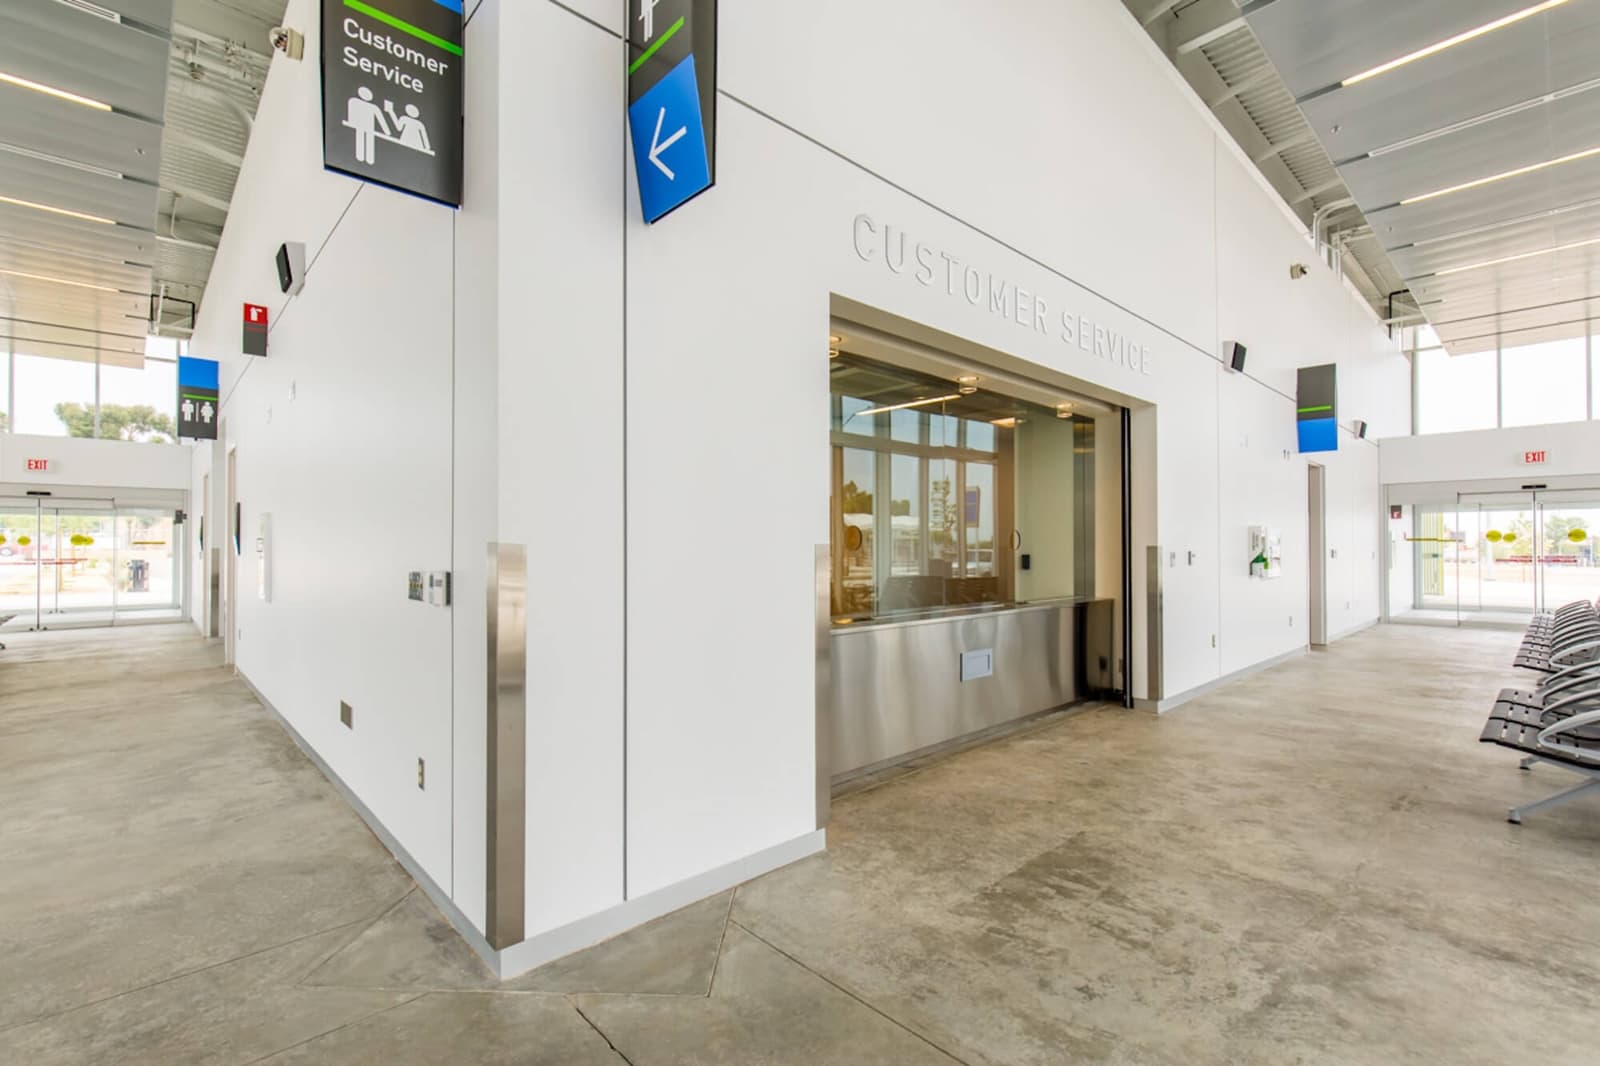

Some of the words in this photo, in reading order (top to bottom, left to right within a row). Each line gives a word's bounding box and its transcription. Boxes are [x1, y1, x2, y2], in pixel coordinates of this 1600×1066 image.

[343, 18, 448, 75] Customer
[343, 46, 424, 93] Service
[853, 213, 1048, 335] CUSTOMER
[1061, 311, 1151, 377] SERVICE
[27, 459, 48, 470] EXIT
[1525, 451, 1545, 463] EXIT
